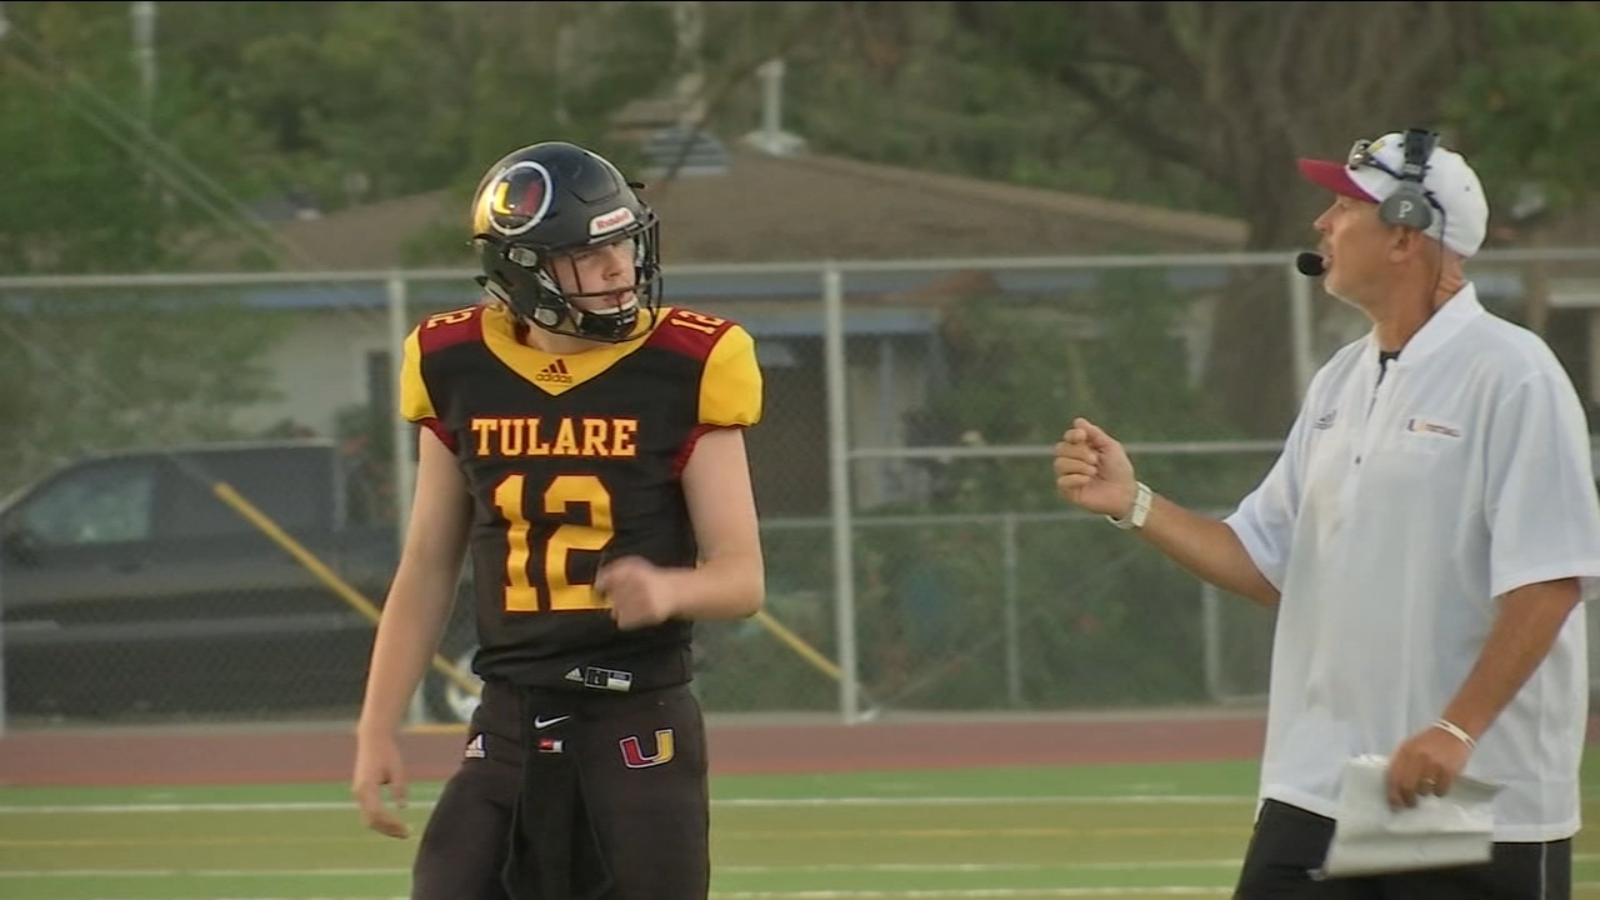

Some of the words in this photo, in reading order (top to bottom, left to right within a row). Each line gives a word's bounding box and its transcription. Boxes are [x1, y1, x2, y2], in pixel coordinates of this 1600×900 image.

[670, 310, 726, 335] 12
[535, 373, 573, 384] adidas
[471, 416, 638, 458] TULARE
[493, 473, 616, 613] 12
[619, 728, 675, 768] U
